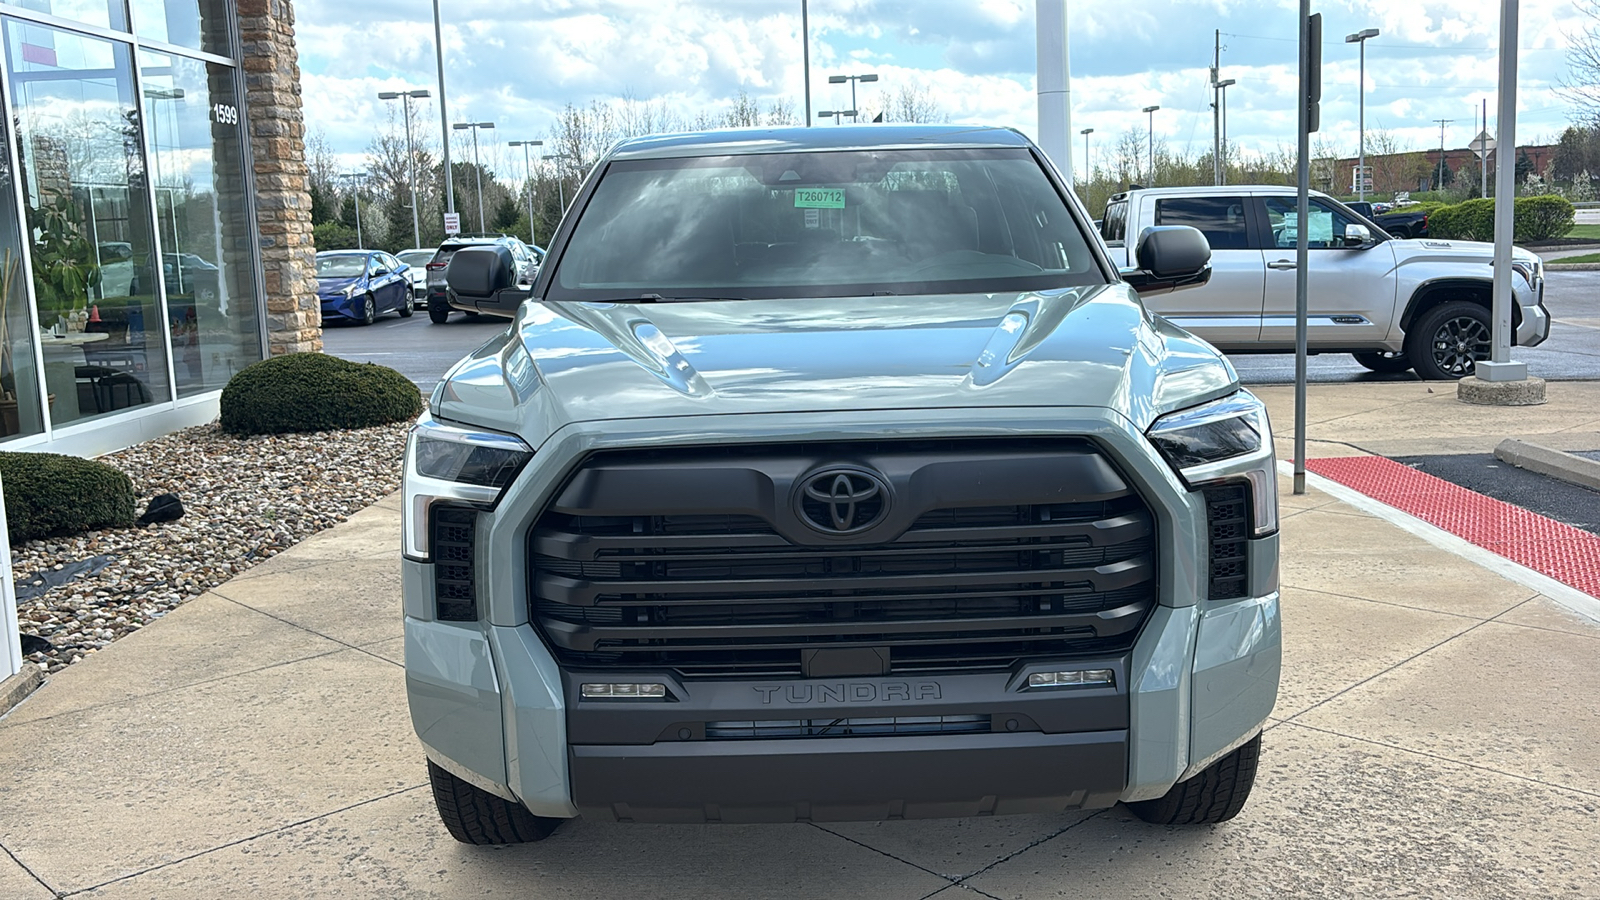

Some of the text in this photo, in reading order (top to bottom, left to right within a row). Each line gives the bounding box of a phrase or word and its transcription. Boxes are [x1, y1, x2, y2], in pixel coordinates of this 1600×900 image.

[213, 103, 237, 125] 1599
[798, 191, 841, 202] T260712
[752, 681, 942, 704] TUNDRA
